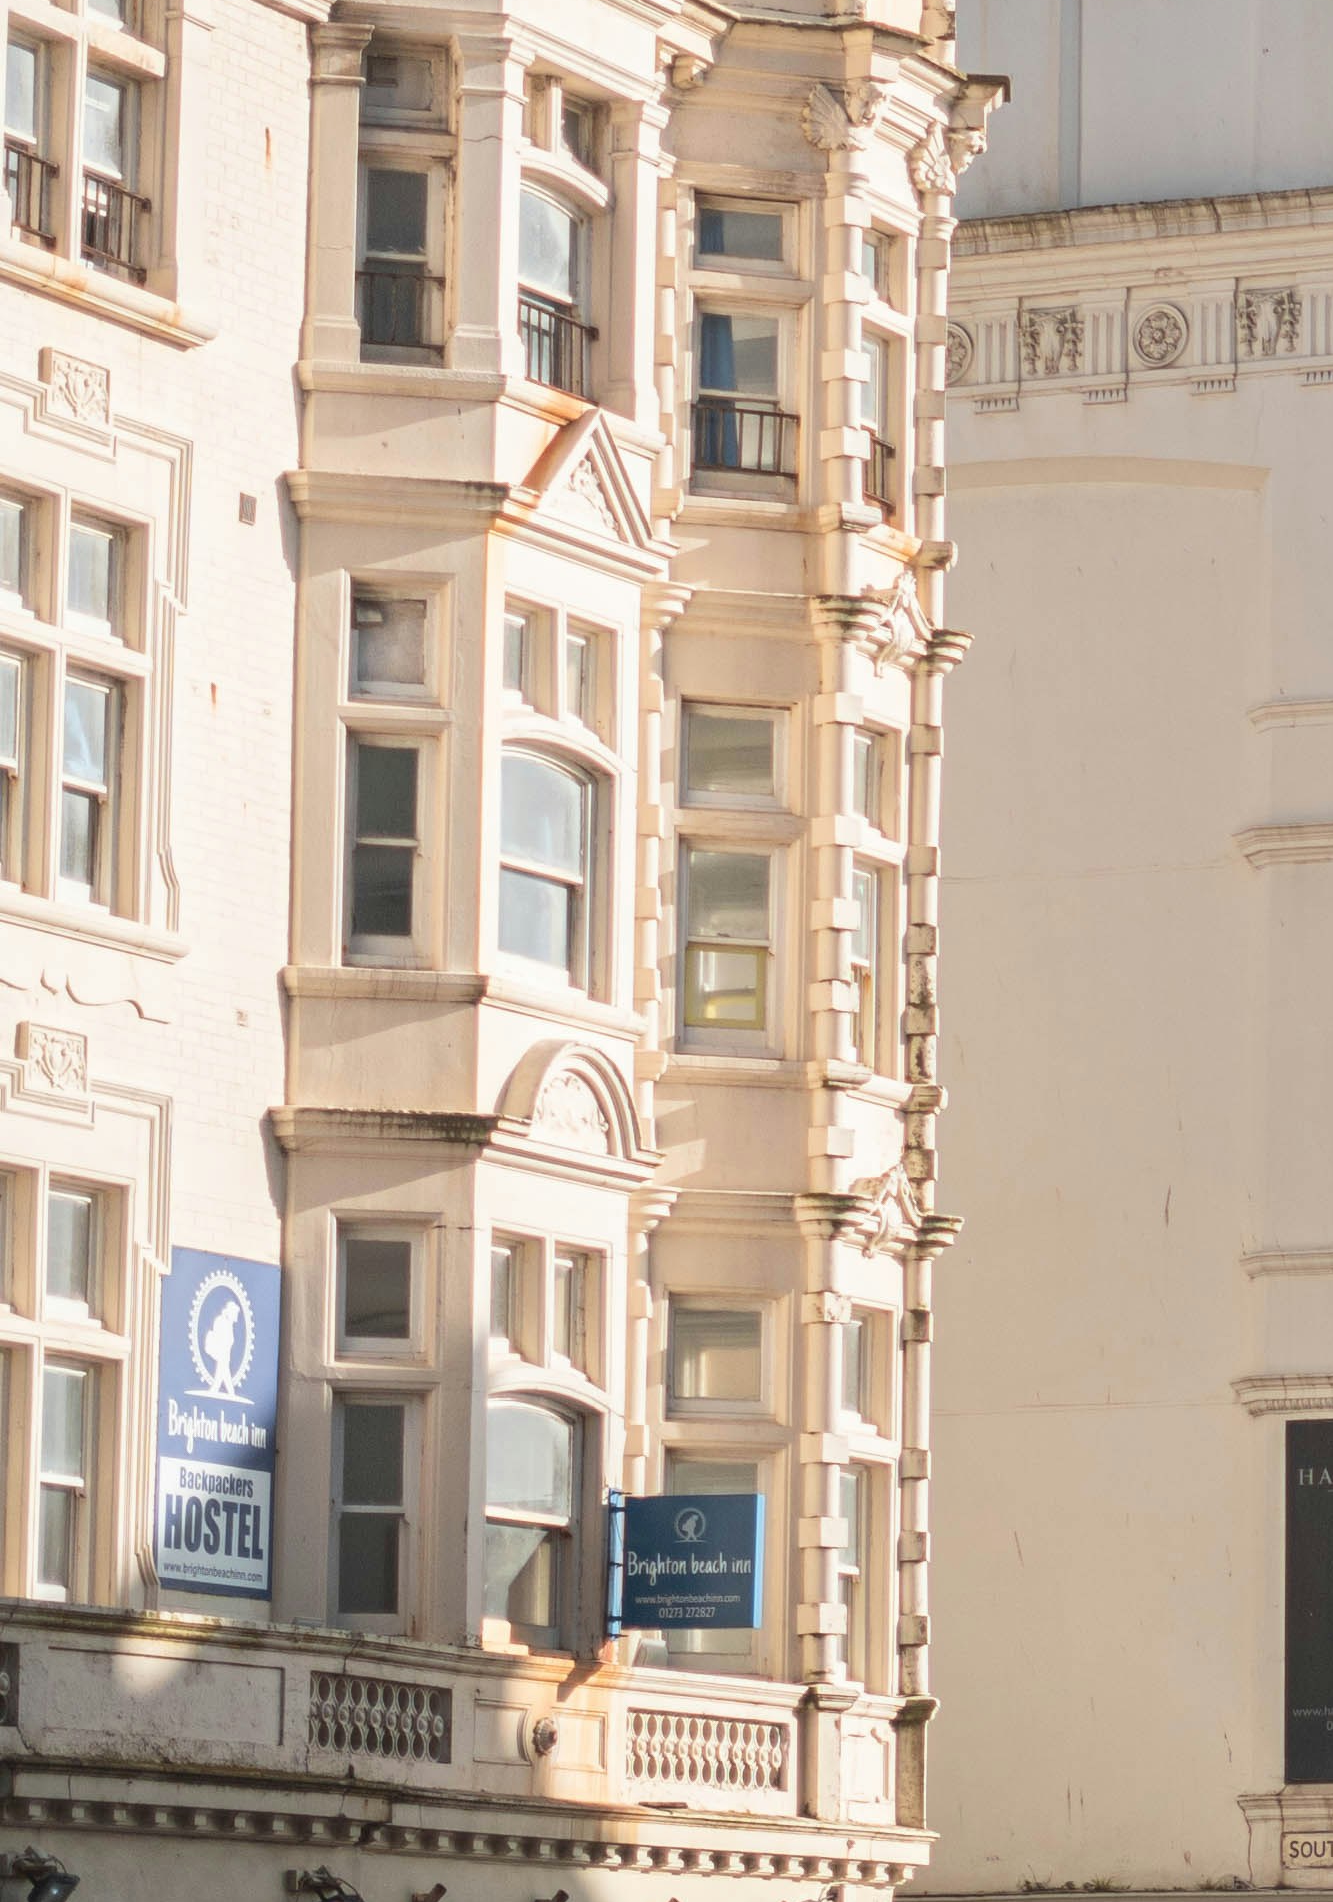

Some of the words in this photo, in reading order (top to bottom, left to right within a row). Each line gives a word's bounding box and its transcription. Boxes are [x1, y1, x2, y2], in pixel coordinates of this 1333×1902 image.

[168, 1399, 218, 1454] Brighton
[221, 1410, 248, 1446] beach
[251, 1423, 267, 1450] inn
[180, 1467, 253, 1498] Backpackers
[164, 1494, 263, 1561] HOSTEL
[163, 1561, 263, 1584] www.brightonbeachinn.com
[627, 1551, 687, 1586] Brighton
[691, 1552, 727, 1574] beach
[732, 1557, 751, 1574] inn
[635, 1594, 741, 1606] www.brightonbeachinn.com
[659, 1608, 683, 1618] 01273
[686, 1607, 716, 1618] 272827
